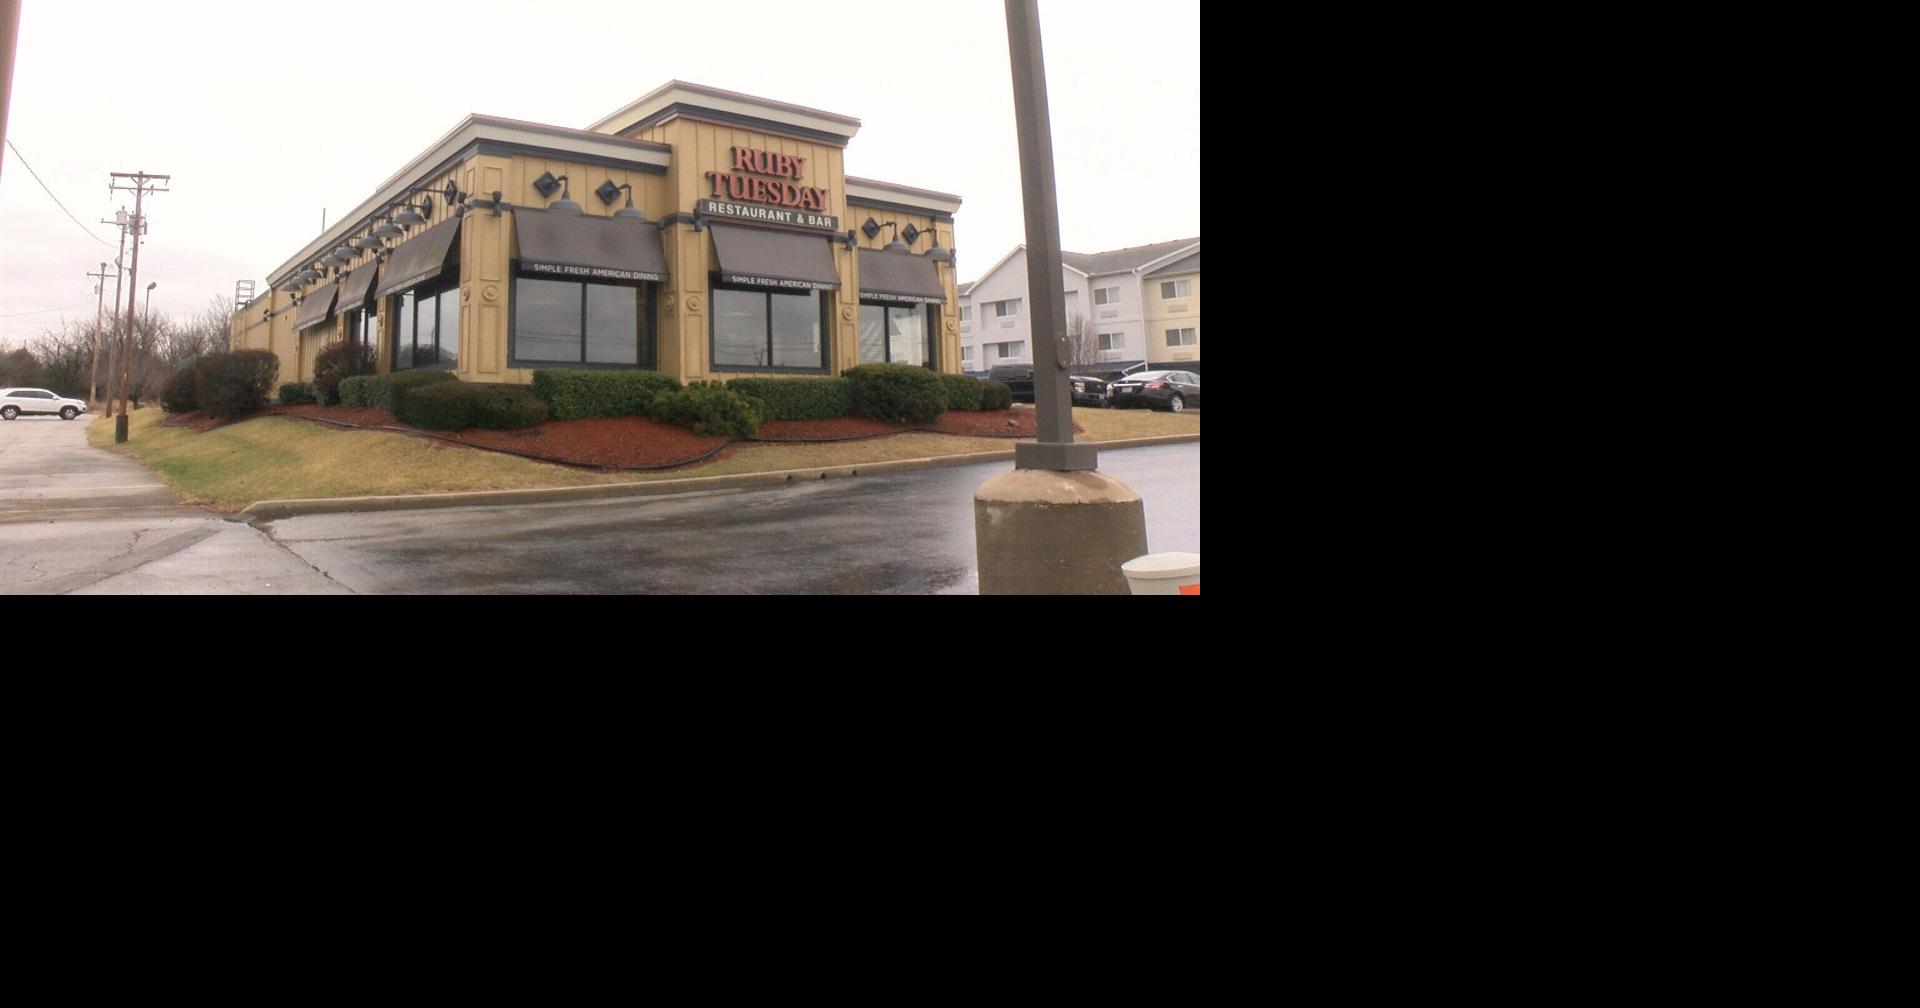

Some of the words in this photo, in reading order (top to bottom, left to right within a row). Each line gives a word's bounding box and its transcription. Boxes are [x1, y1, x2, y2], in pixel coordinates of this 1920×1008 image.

[731, 146, 806, 180] RUBY
[706, 171, 827, 211] TUESDAY
[708, 202, 792, 221] RESTAURANT
[797, 213, 804, 224] &
[808, 215, 832, 227] BAR
[534, 263, 561, 273] SIMPLE
[564, 265, 590, 275] FRESH
[592, 268, 631, 278] AMERICAN
[633, 272, 659, 281] DINING
[732, 275, 754, 284] SIMPLE
[757, 277, 778, 286] FRESH
[779, 279, 811, 289] AMERICAN
[812, 282, 833, 290] DINING
